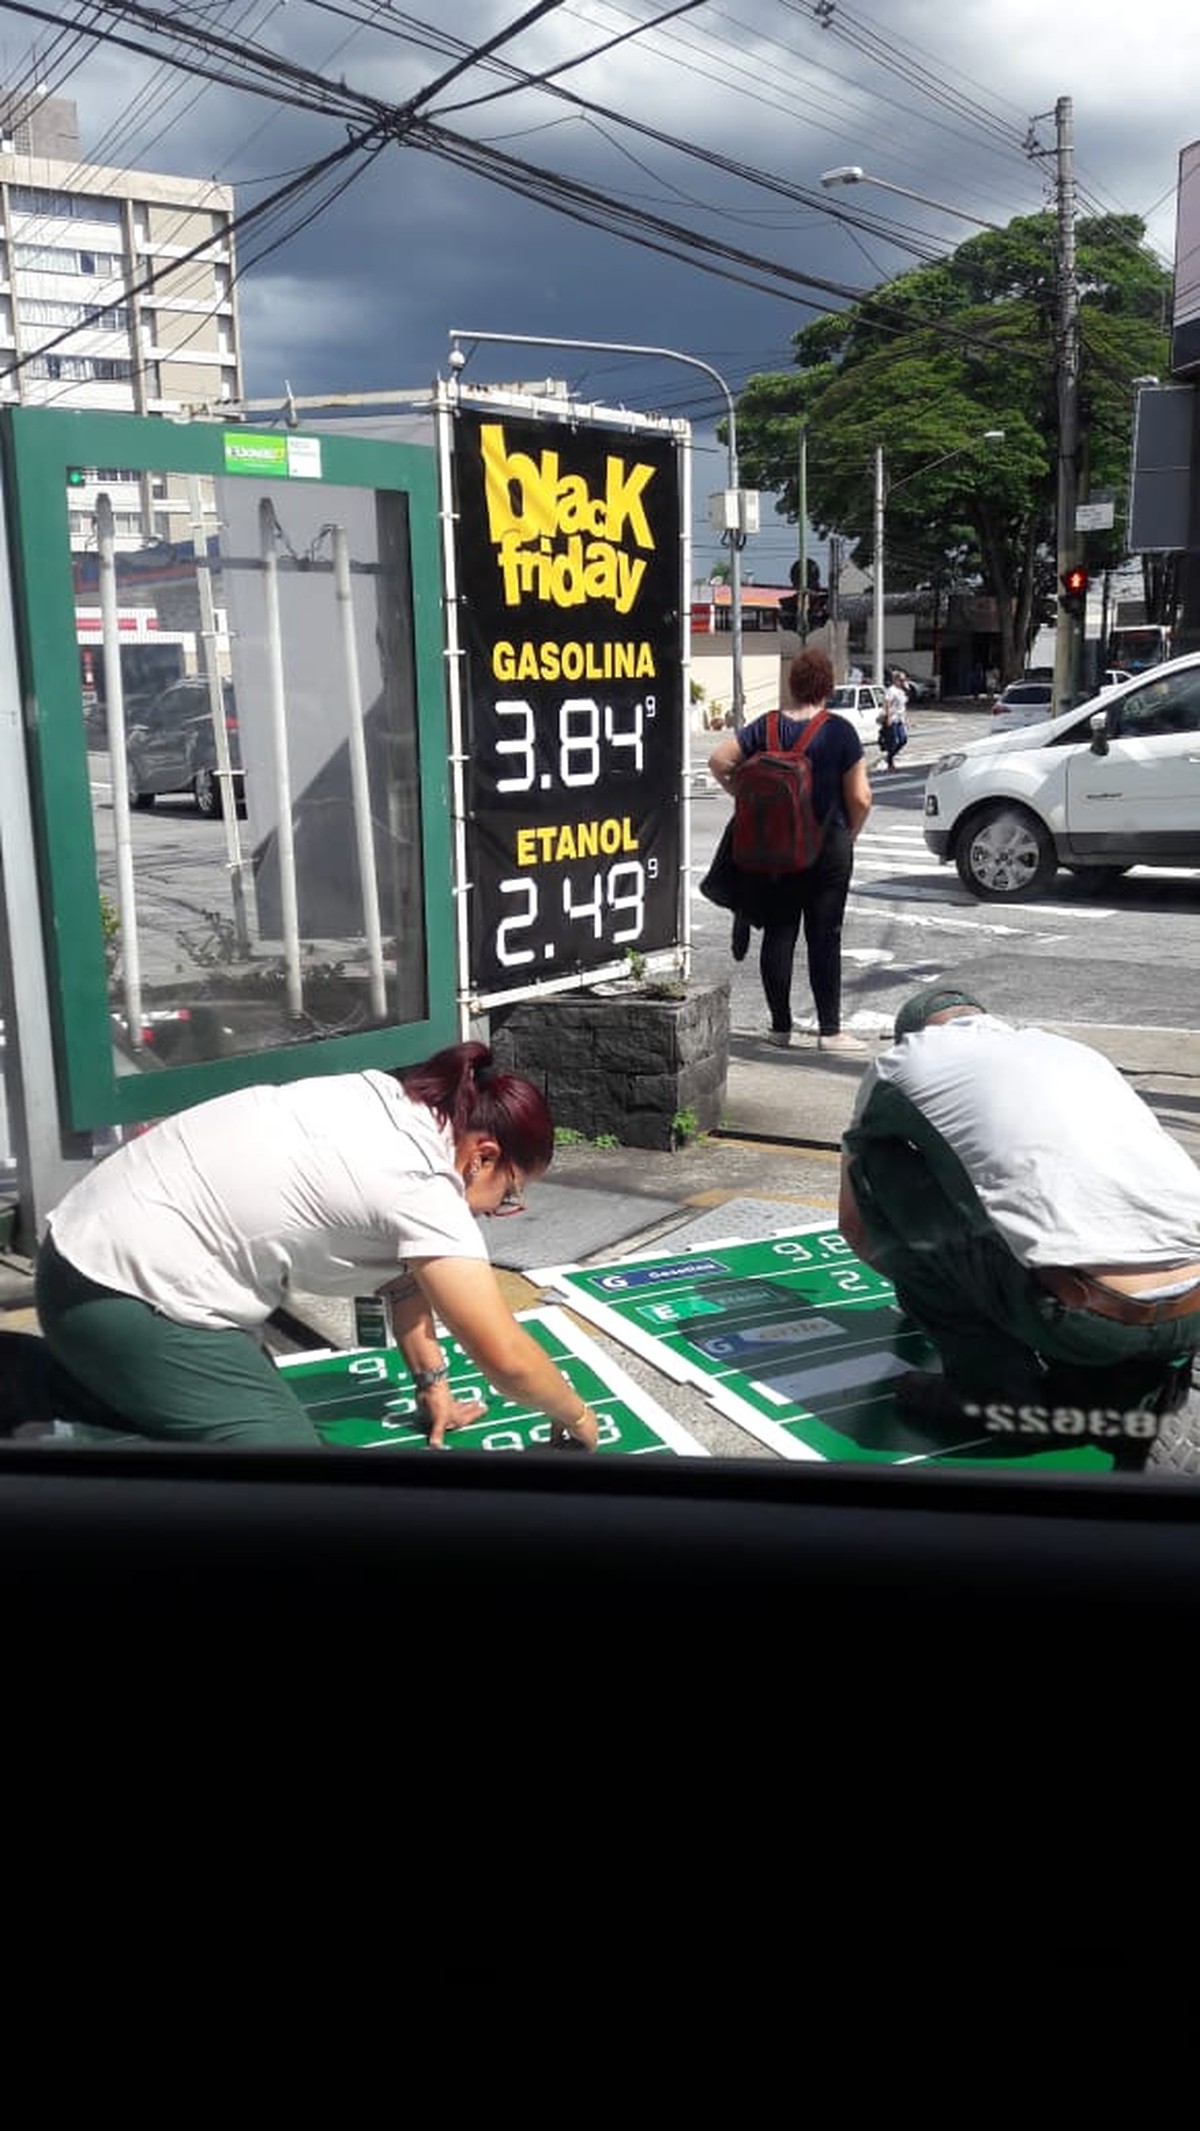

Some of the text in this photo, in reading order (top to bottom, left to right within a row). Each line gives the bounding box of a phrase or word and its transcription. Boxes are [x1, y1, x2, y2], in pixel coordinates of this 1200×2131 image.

[498, 531, 647, 614] friday
[493, 641, 655, 681] GASOLINA
[517, 816, 639, 866] ETANOL
